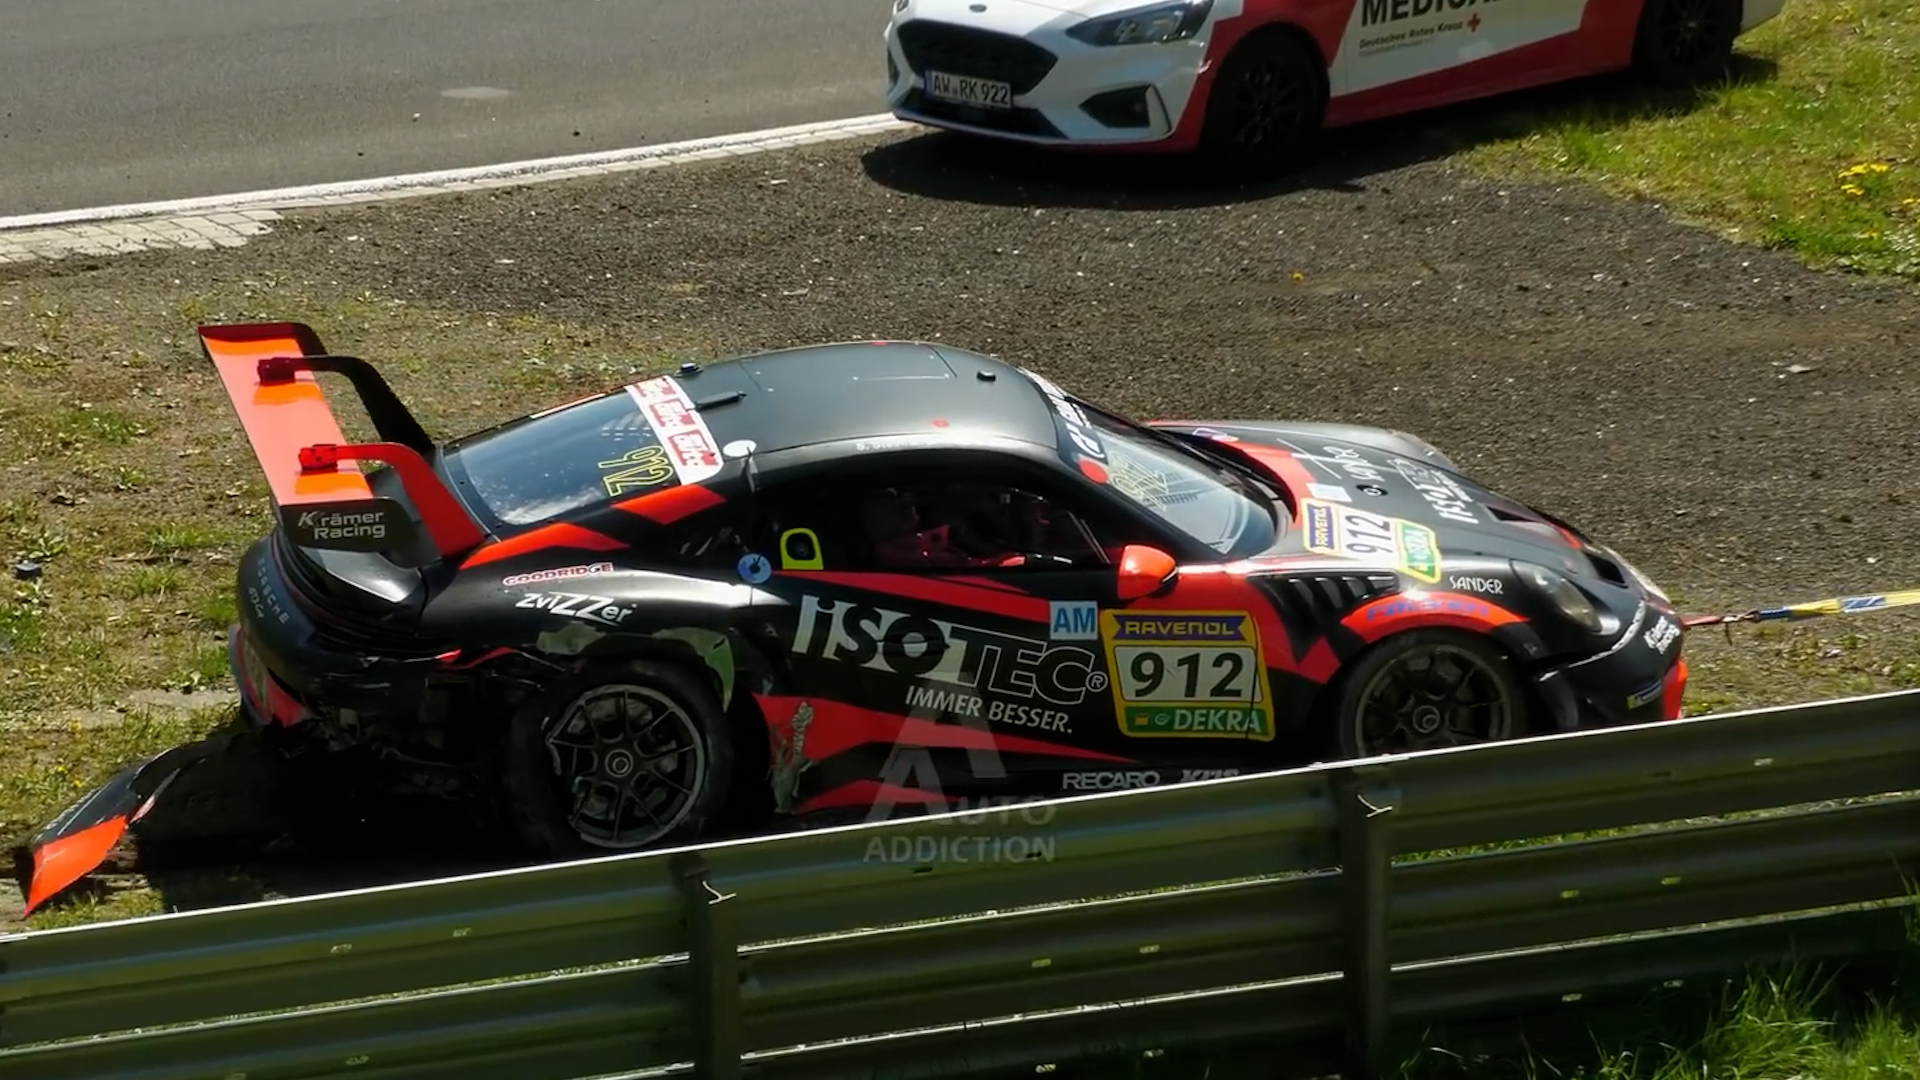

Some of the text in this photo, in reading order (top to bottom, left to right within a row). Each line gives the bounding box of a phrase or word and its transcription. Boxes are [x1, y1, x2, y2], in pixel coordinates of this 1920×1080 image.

[933, 74, 1010, 104] AW RK 922
[298, 510, 385, 528] Krämer
[314, 524, 386, 540] Racing
[1345, 514, 1393, 554] 912
[503, 563, 613, 587] GOODRIDGE
[1449, 575, 1504, 595] SANDER
[1052, 606, 1096, 634] AM
[1124, 620, 1236, 636] RAVENOL
[1130, 651, 1244, 698] 912
[904, 684, 1074, 734] IMMER BESSER.
[1173, 708, 1262, 733] DEKRA
[1062, 770, 1161, 791] RECARO
